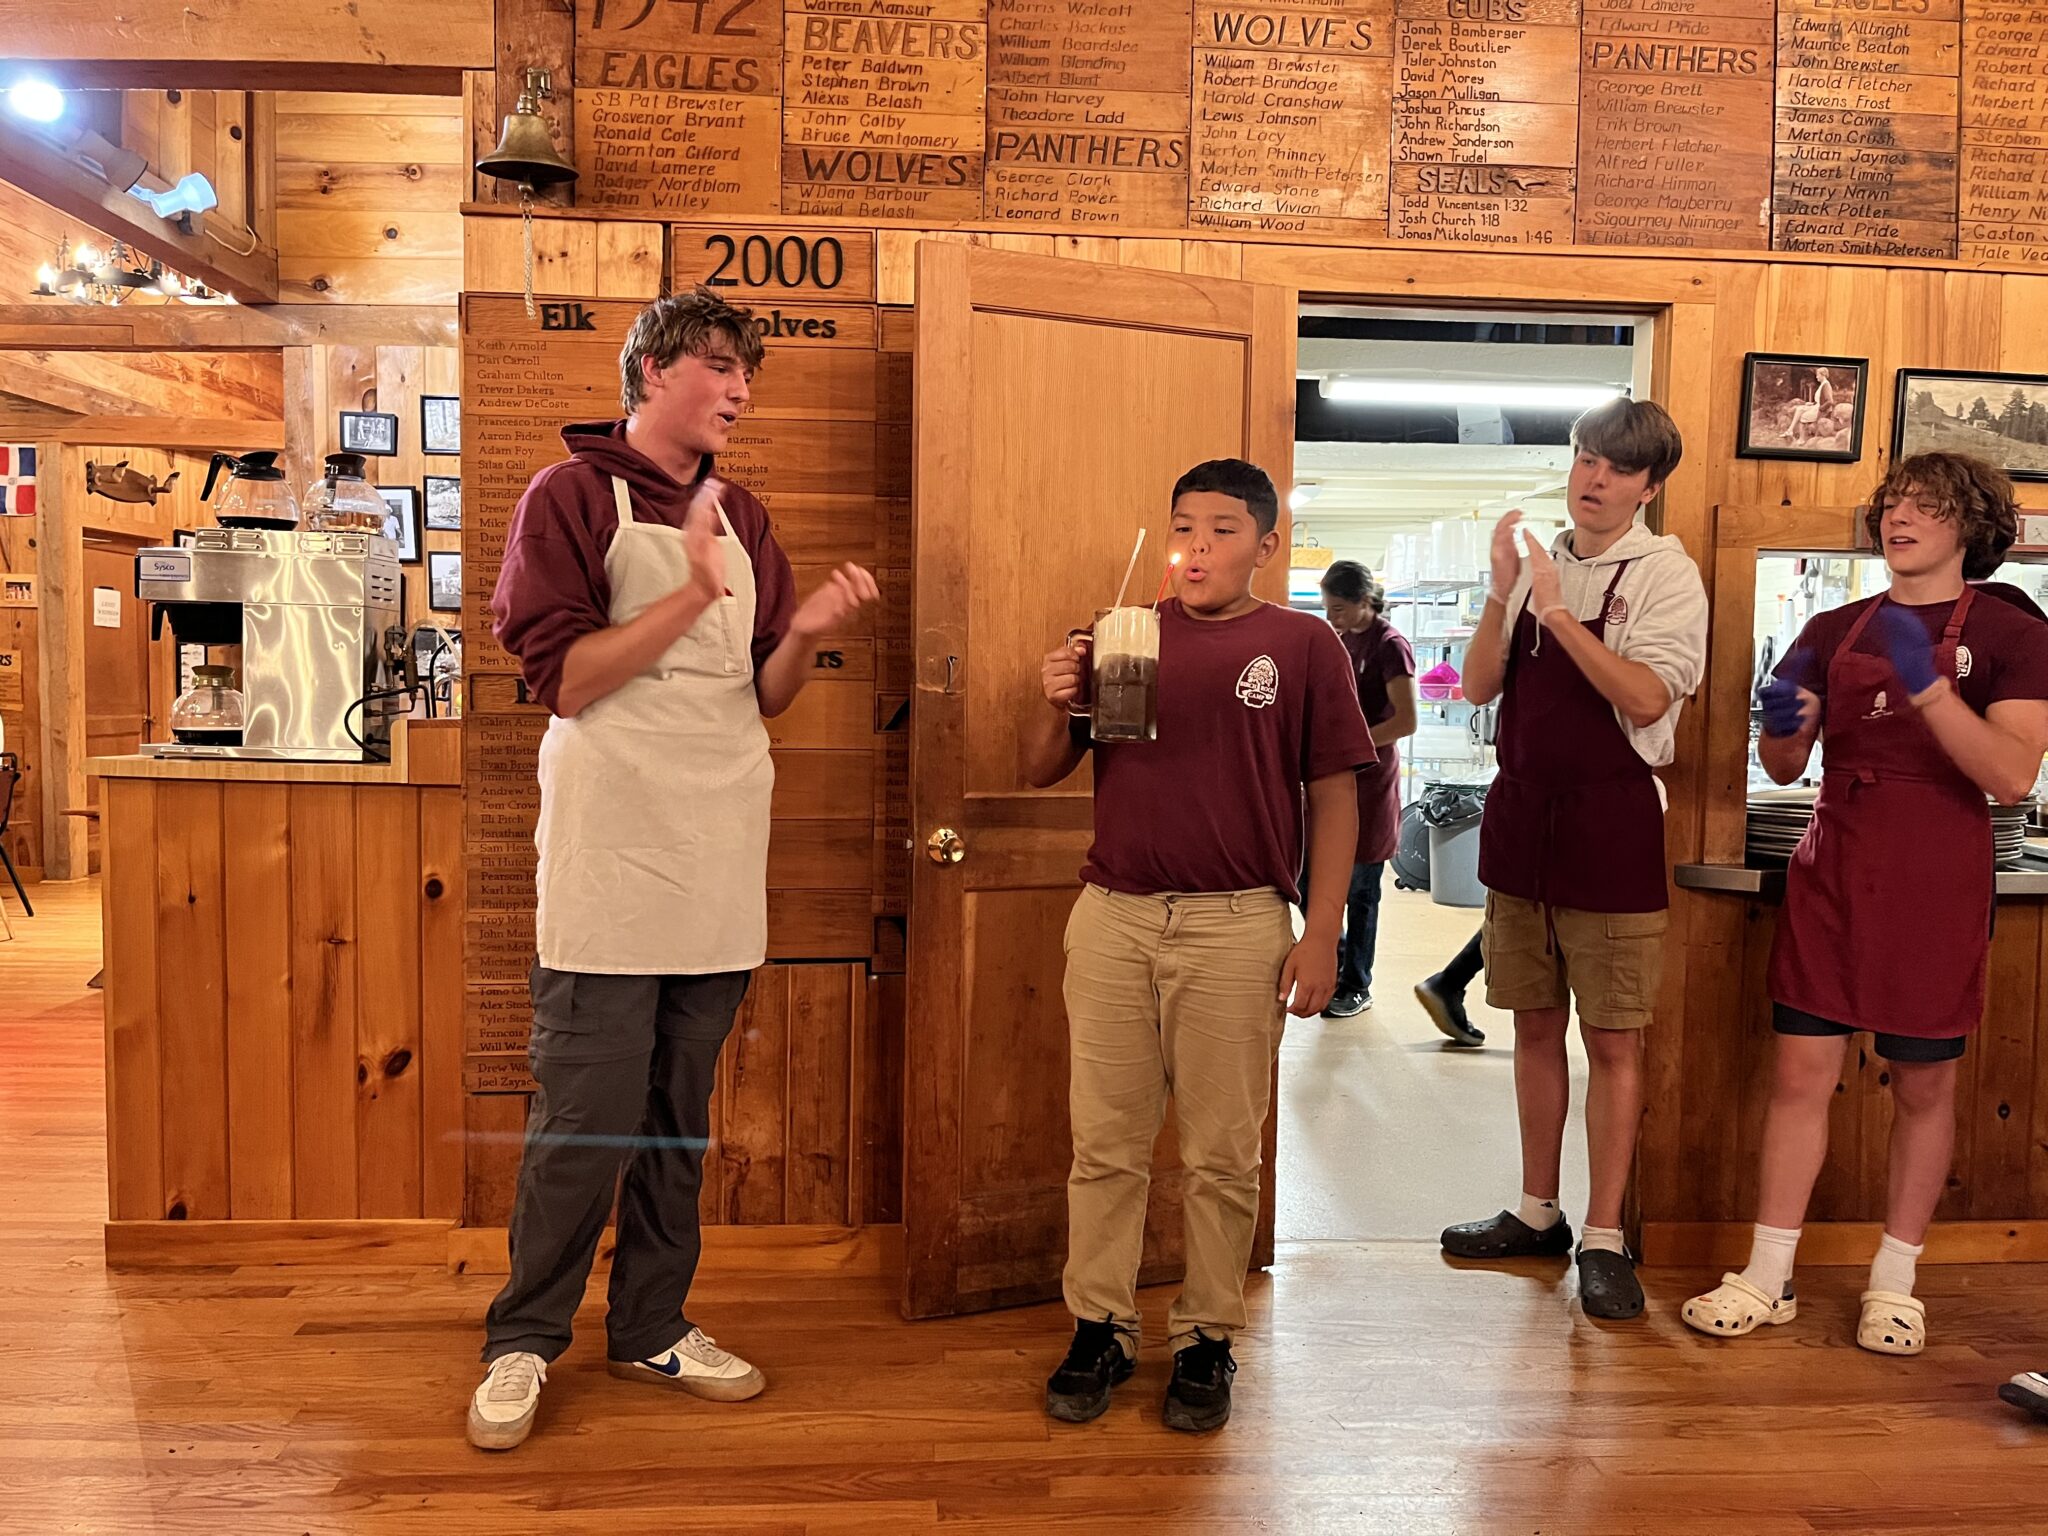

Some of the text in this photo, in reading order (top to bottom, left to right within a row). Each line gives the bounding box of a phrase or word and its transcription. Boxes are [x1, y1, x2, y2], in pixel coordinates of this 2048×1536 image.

[869, 0, 935, 16] Mansur
[1448, 0, 1526, 21] CUBS
[1214, 12, 1372, 50] WOLVES
[1402, 22, 1526, 39] Jonah Bamberger
[1793, 18, 1841, 34] Edward
[804, 17, 979, 60] BEAVERS
[1402, 36, 1511, 54] Derek Boutilier
[1791, 37, 1909, 56] Maurice Beaton
[802, 56, 923, 75] Peter Baldwin
[1205, 54, 1255, 69] William
[1403, 52, 1496, 69] Tyler Johnston
[1593, 42, 1757, 74] PANTHERS
[1792, 55, 1899, 73] John Brewster
[1975, 59, 2032, 74] Robert
[601, 53, 759, 92] EAGLES
[1204, 71, 1337, 91] Robert Brundage
[1401, 69, 1484, 85] David Morey
[802, 74, 929, 92] Stephen Brown
[1597, 80, 1702, 96] George Brett
[1788, 73, 1912, 93] Harold Fletcher
[802, 91, 922, 109] Alexis Belash
[1001, 90, 1104, 108] John Harvey
[1203, 91, 1343, 109] Harold Cranshaw
[1400, 83, 1499, 101] Jason Mulligan
[666, 95, 744, 111] Brewster
[1400, 100, 1485, 116] Joshua Pincus
[1597, 99, 1724, 116] William Brewster
[1790, 92, 1891, 110] Stevens Frost
[593, 109, 746, 129] Grosvenor Bryant
[802, 111, 905, 130] John Colby
[1086, 111, 1124, 124] Ladd
[1203, 108, 1316, 126] Lewis Johnson
[1400, 116, 1499, 132] John Richardson
[1596, 117, 1681, 133] Erik Brown
[1788, 110, 1834, 124] James
[594, 125, 695, 142] Ronald Cole
[802, 128, 958, 147] Bruce Montgomery
[1202, 126, 1285, 143] John Lacy
[1399, 132, 1513, 149] Andrew Sanderson
[1788, 128, 1841, 143] Merton
[594, 141, 740, 161] Thornton Gifford
[995, 132, 1184, 168] PANTHERS
[1662, 139, 1721, 154] Fletcher
[1267, 147, 1326, 164] Phinney
[1399, 147, 1487, 164] Shawn Trudel
[1790, 146, 1907, 167] Julian Jaynes
[594, 158, 715, 176] David Lamere
[802, 149, 967, 186] WOLVES
[1789, 164, 1893, 183] Robert Liming
[659, 177, 740, 193] Nordblom
[1201, 177, 1319, 198] Edward Stone
[1419, 167, 1506, 193] SEALS
[1594, 174, 1653, 189] Richard
[865, 188, 932, 201] Barbour
[996, 188, 1117, 204] Richard Power
[1790, 182, 1889, 201] Harry Nawn
[1969, 184, 2029, 200] William
[652, 192, 709, 209] Willey
[1200, 196, 1320, 214] Richard Vivian
[1401, 195, 1527, 212] Todd Vincentsen 1:32
[800, 202, 914, 218] David Belash
[995, 206, 1119, 222] Leonard Brown
[1788, 200, 1890, 219] Jack Potter
[1969, 203, 2020, 220] Henry
[1200, 214, 1304, 231] William Wood
[1399, 210, 1499, 227] Josh Church 1:18
[1398, 226, 1552, 244] Jonas Mikolayunas 1:46
[1784, 220, 1898, 238] Edward Pride
[1973, 224, 2034, 242] Gaston
[1784, 239, 1943, 258] Morten Smith-Petersen
[1972, 245, 2010, 259] Hale
[704, 234, 844, 290] 2000
[540, 303, 837, 339] Elk olves
[510, 341, 547, 351] Arnold
[477, 355, 540, 366] Dan Carroll
[477, 371, 564, 381] Graham Chilton
[477, 384, 513, 394] Trevor
[478, 399, 569, 409] Andrew DeCoste
[478, 432, 511, 441] Aaron
[479, 446, 534, 457] Adam Foy
[478, 461, 525, 470] Silas Gill
[728, 464, 768, 475] Knights
[479, 475, 502, 485] John
[480, 504, 509, 514] Drew
[480, 519, 507, 528] Mike
[154, 562, 175, 571] Sysco
